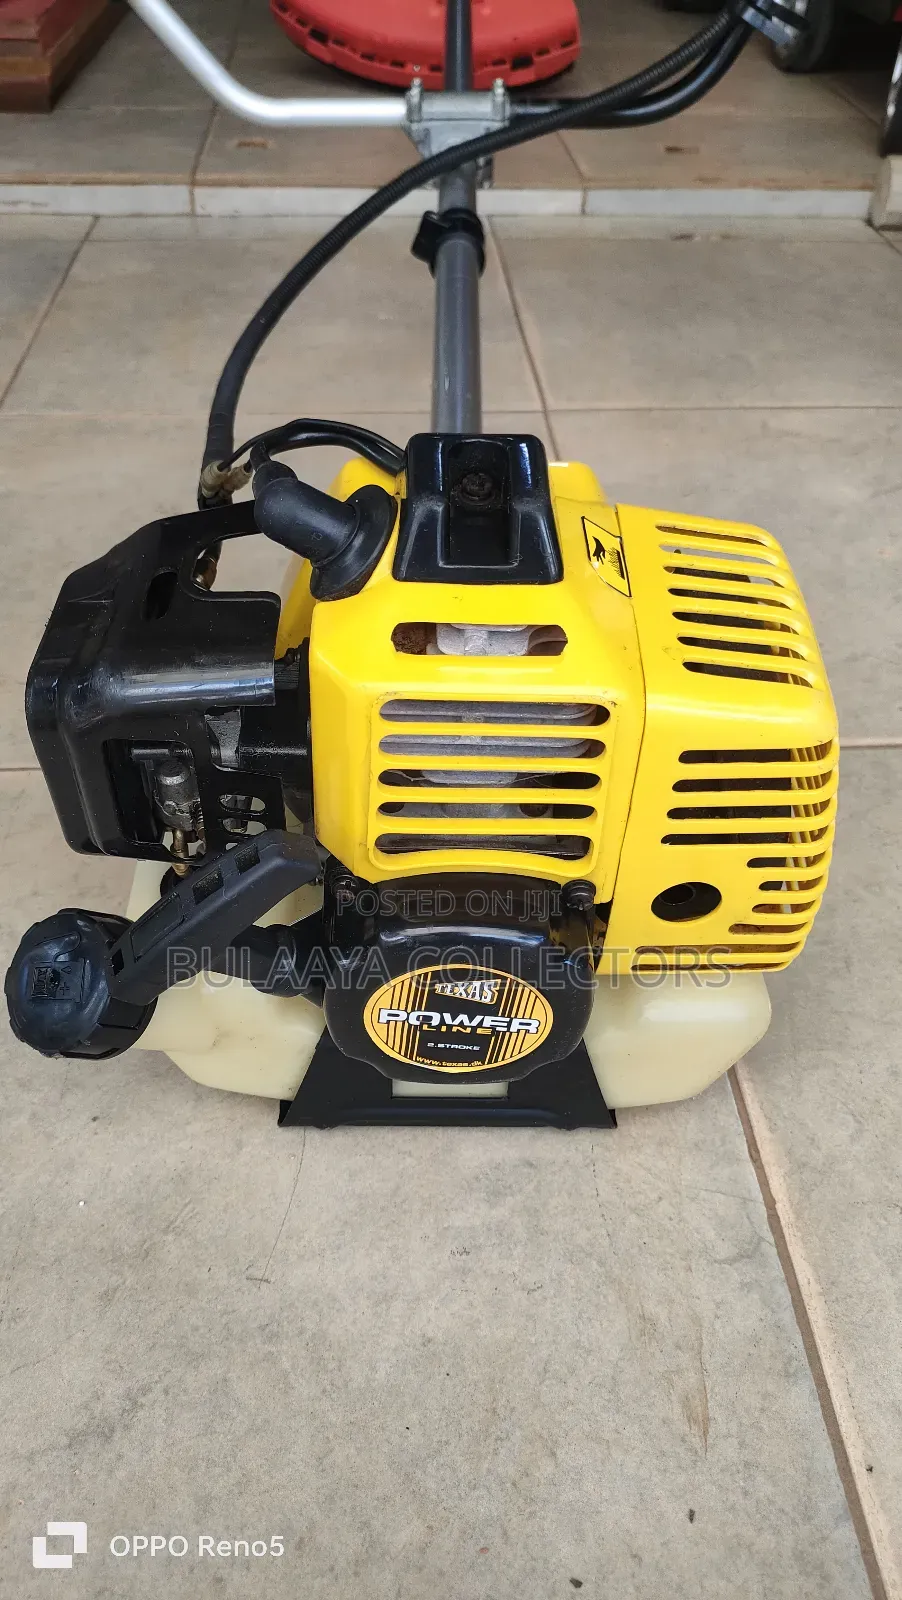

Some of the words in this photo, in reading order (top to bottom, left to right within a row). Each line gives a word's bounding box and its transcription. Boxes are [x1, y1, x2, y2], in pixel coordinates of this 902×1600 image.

[436, 979, 500, 1004] TEXAS
[378, 1008, 540, 1034] POWER
[422, 1025, 493, 1035] LINE
[416, 1056, 483, 1067] www.texas.dk
